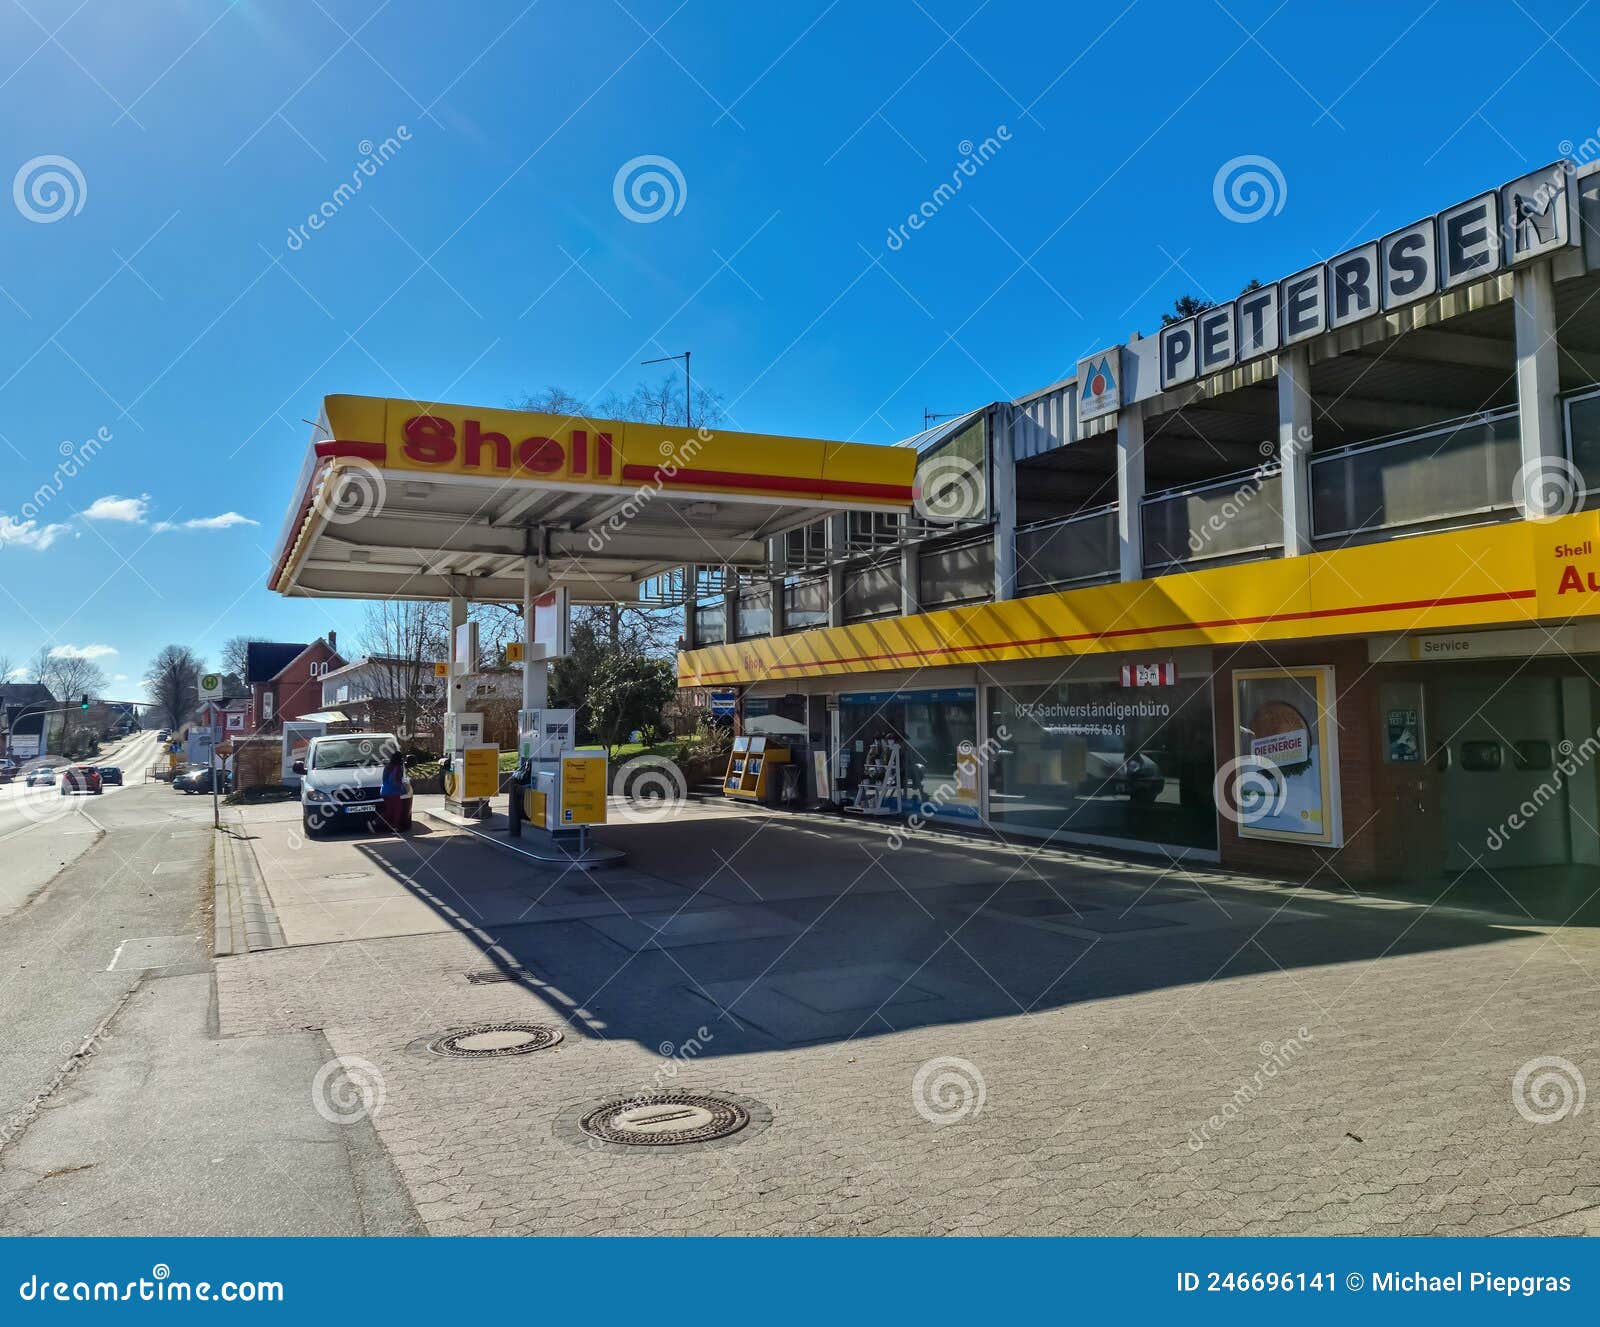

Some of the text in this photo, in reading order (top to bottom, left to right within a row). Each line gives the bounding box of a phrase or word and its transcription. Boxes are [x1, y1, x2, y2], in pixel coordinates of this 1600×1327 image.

[403, 415, 613, 476] Shell
[1555, 541, 1592, 558] Shell
[1424, 640, 1470, 653] Service
